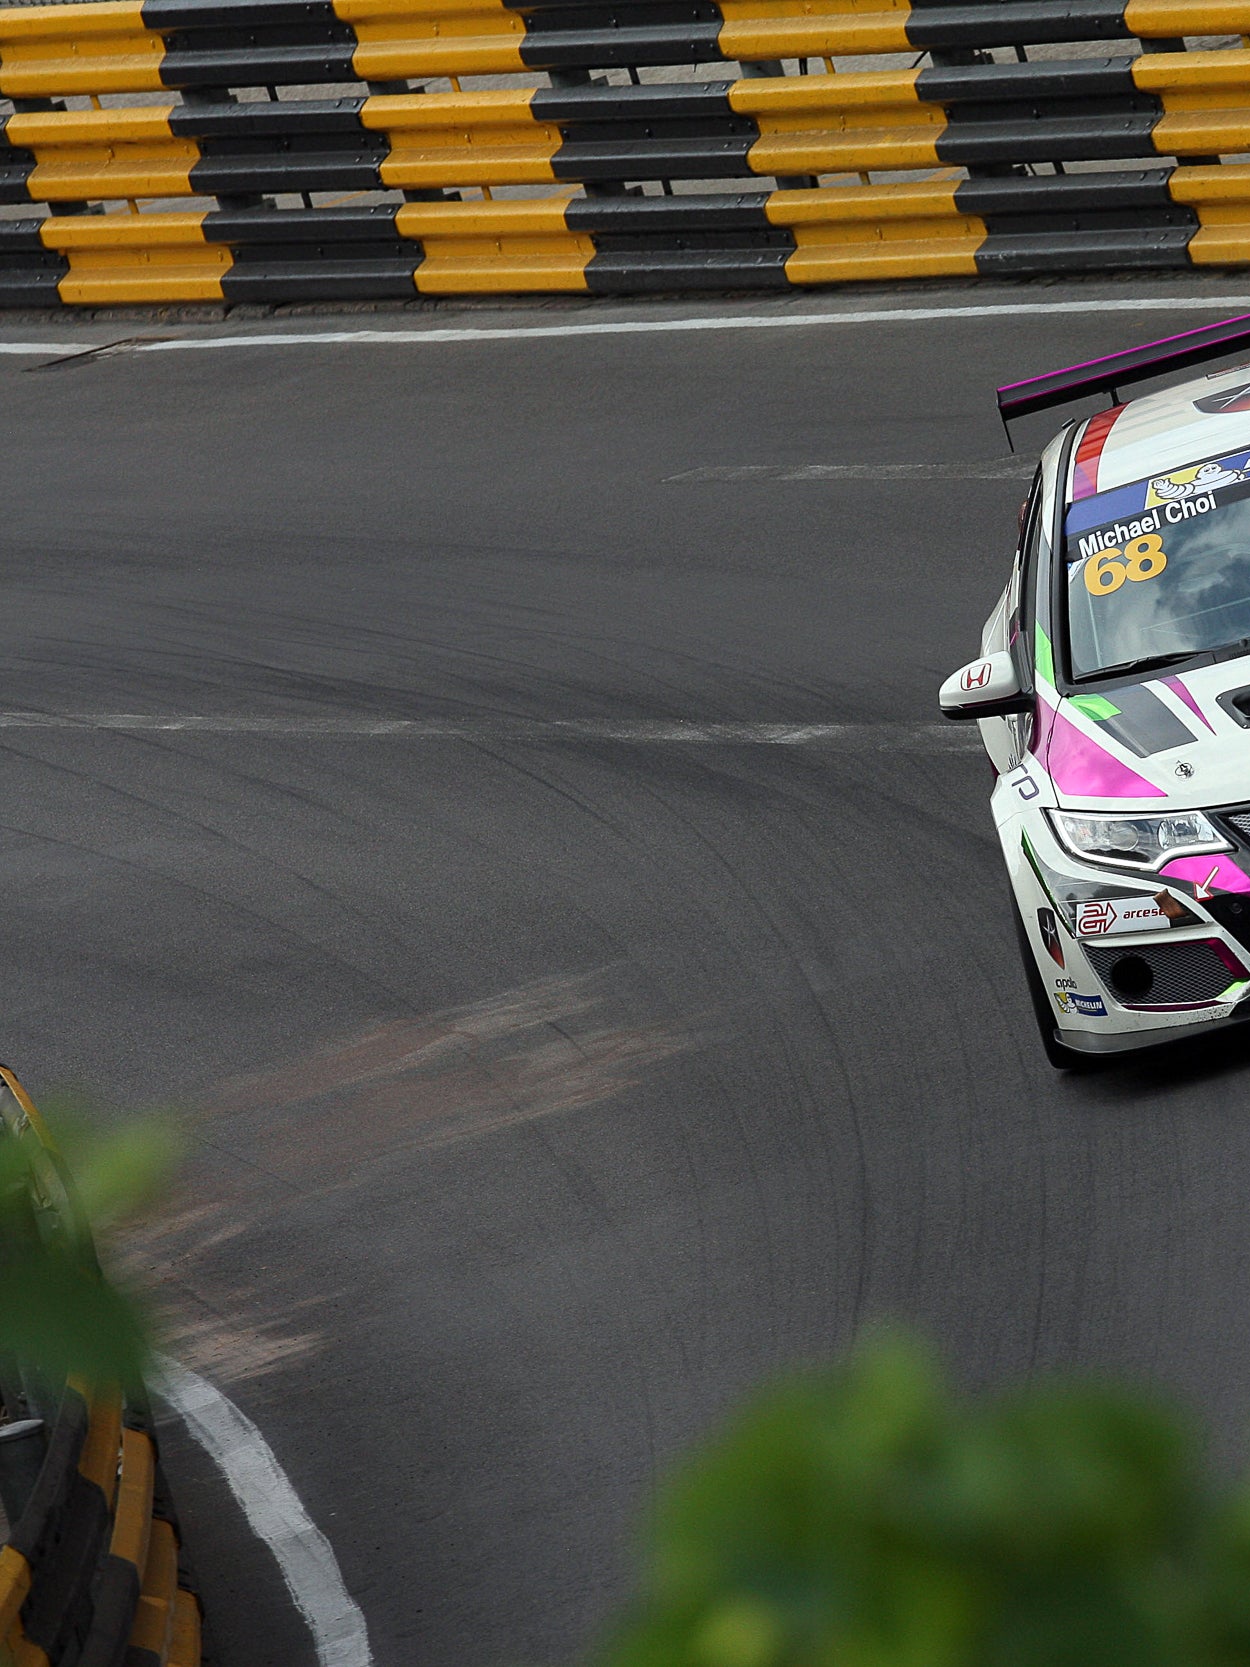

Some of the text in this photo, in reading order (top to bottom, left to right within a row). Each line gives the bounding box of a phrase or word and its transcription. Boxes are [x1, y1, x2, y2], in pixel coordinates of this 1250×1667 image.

[1078, 491, 1217, 558] Michael Choi
[1083, 533, 1168, 596] 68
